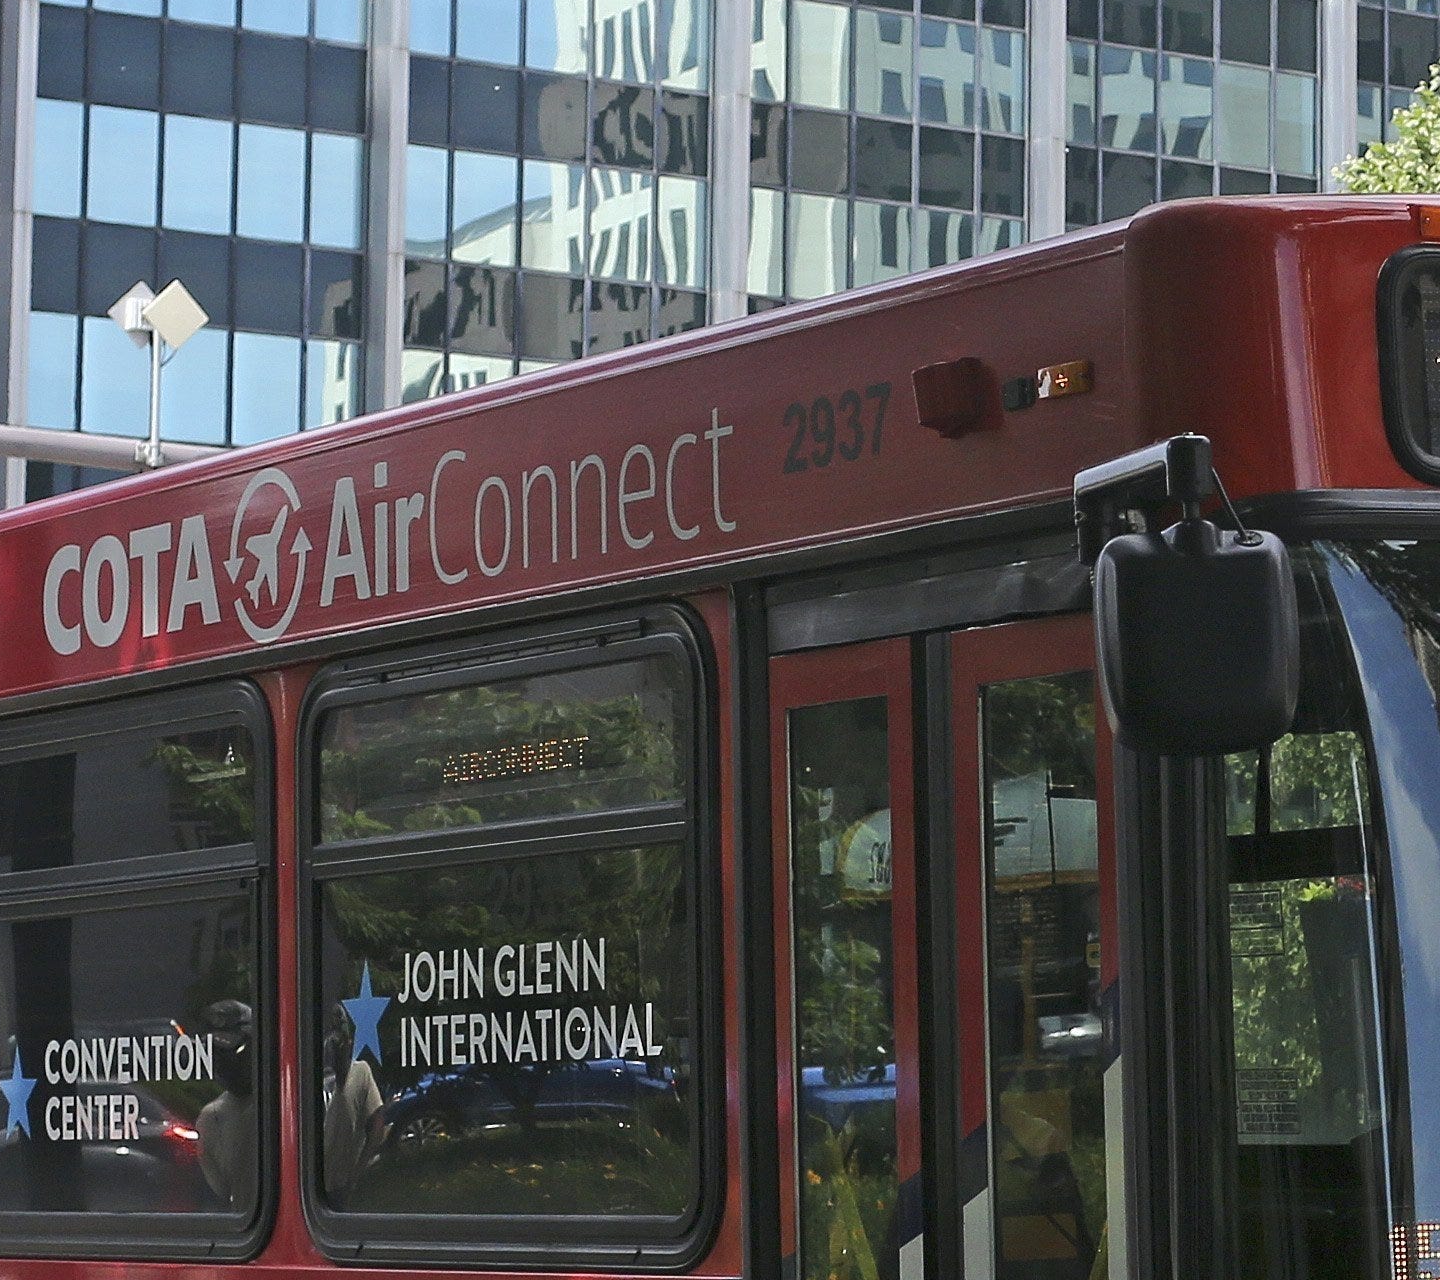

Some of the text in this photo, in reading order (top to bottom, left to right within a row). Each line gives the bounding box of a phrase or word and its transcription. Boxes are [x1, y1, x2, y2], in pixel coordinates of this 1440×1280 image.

[780, 383, 894, 478] 2937
[42, 405, 738, 656] COTA AirConnect
[443, 735, 590, 784] AIRCONNECT
[397, 937, 606, 1004] JOHN GLENN
[43, 1032, 214, 1086] CONVENTION
[400, 1001, 663, 1068] INTERNATIONAL
[44, 1094, 139, 1141] CENTER
